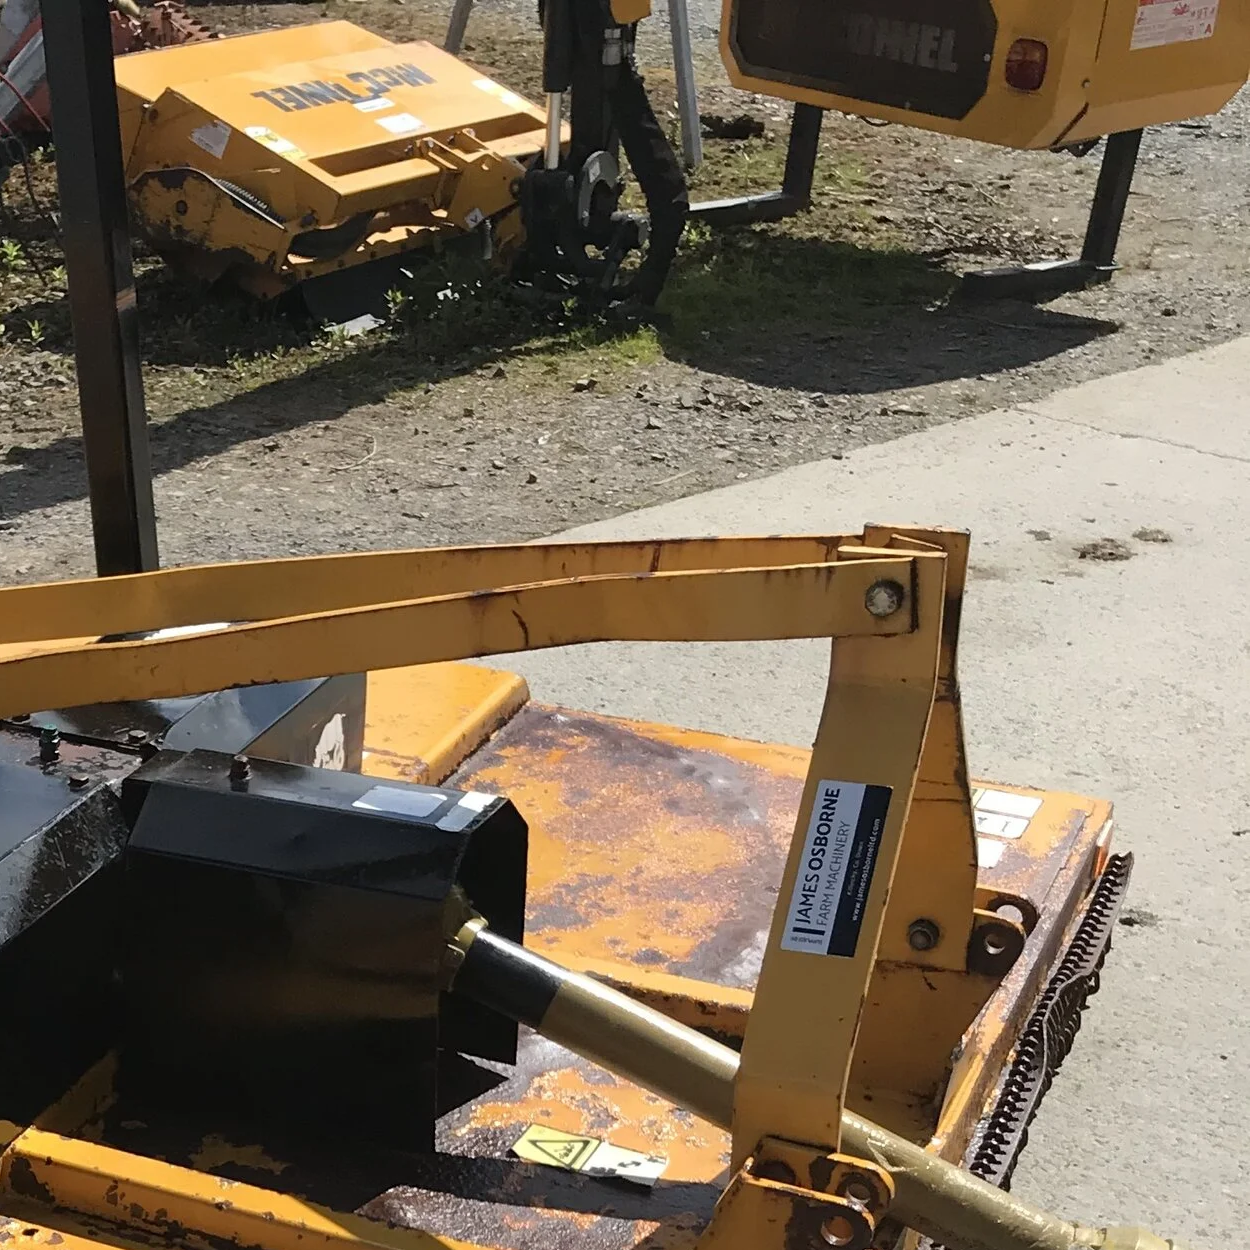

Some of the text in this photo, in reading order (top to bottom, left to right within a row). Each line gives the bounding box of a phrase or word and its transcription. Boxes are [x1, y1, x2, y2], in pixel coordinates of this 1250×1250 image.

[795, 873, 820, 925] JAMES
[808, 788, 841, 871] OSBORNE
[816, 820, 851, 926] FARM MACHINERY
